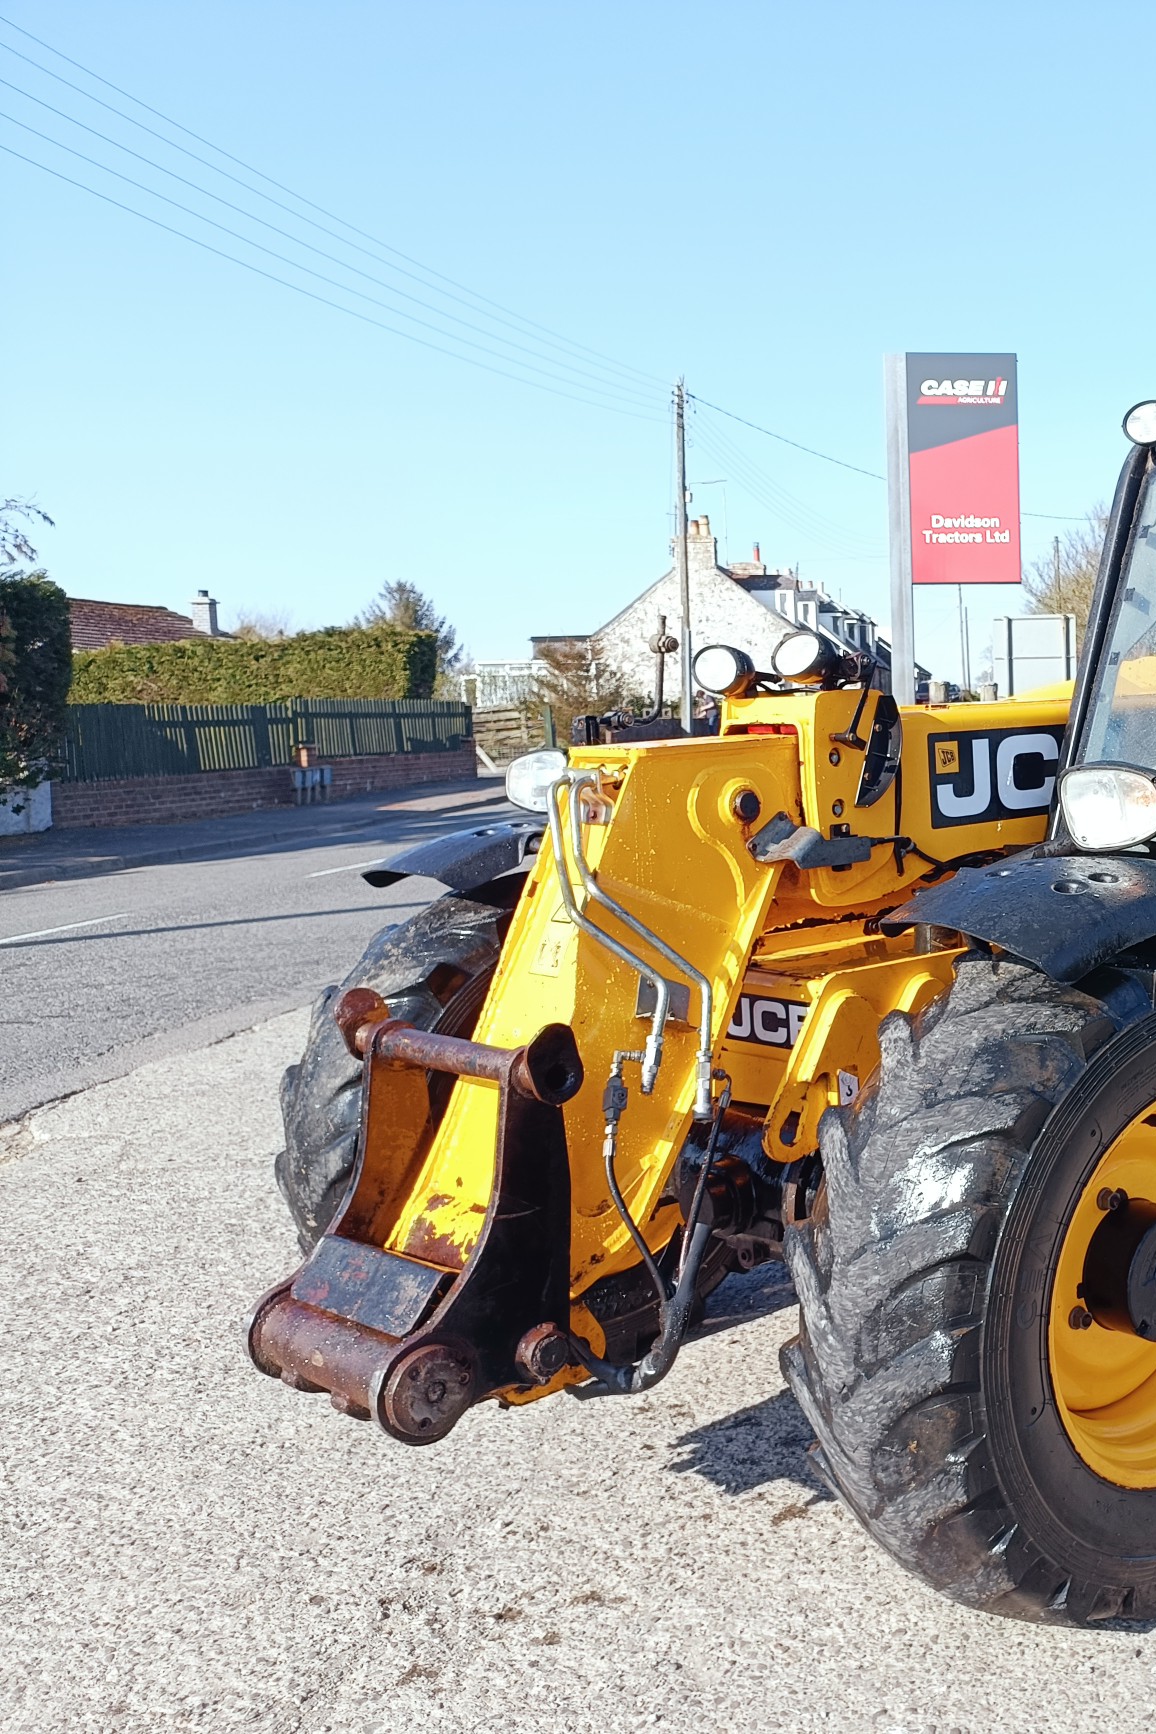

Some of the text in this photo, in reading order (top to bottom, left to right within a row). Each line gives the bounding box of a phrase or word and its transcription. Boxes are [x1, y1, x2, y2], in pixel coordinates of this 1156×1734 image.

[920, 380, 985, 396] CASE
[957, 396, 1001, 404] AGRICULTURE
[931, 514, 1000, 528] Davidson
[922, 529, 1010, 544] Tractors Ltd
[941, 749, 955, 765] JCB
[936, 733, 1059, 818] JC
